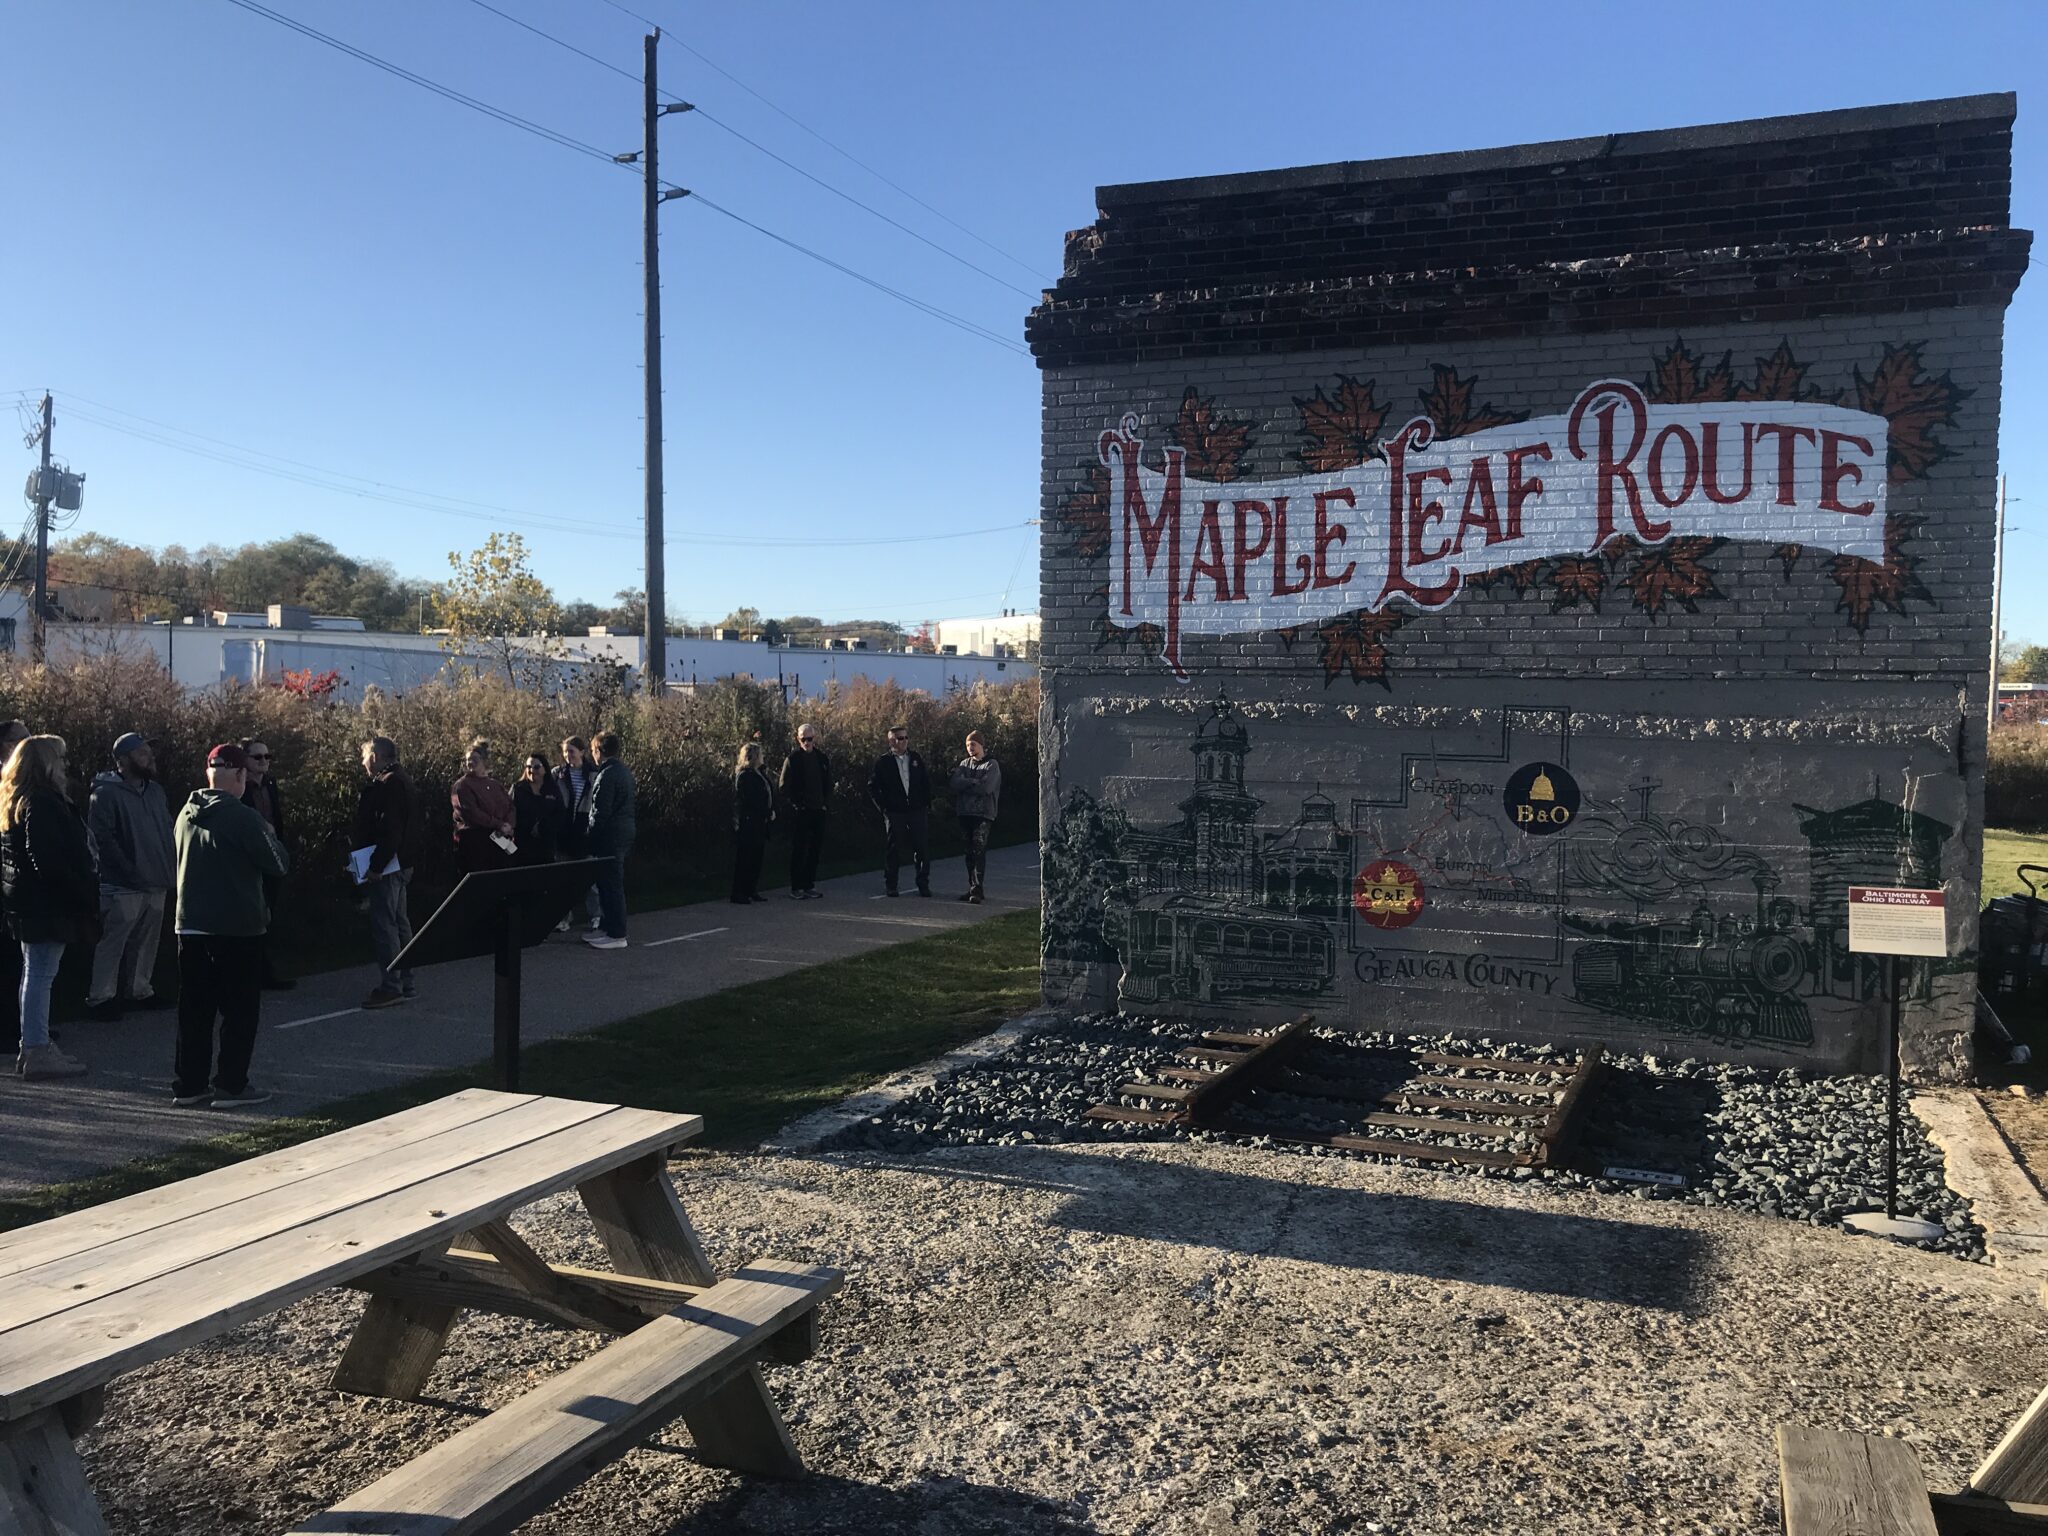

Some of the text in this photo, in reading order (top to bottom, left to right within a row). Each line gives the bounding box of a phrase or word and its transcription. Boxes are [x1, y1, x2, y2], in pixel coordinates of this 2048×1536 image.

[1099, 380, 1876, 680] MAPLE LEAF ROUTE
[1410, 778, 1494, 796] CHARDON
[1516, 804, 1570, 825] B&O
[1435, 856, 1492, 873] BURTON
[1865, 891, 1918, 899] BALTIMORE
[1888, 897, 1931, 905] RAILWAY
[1354, 950, 1559, 995] GEAUGA COUNTY
